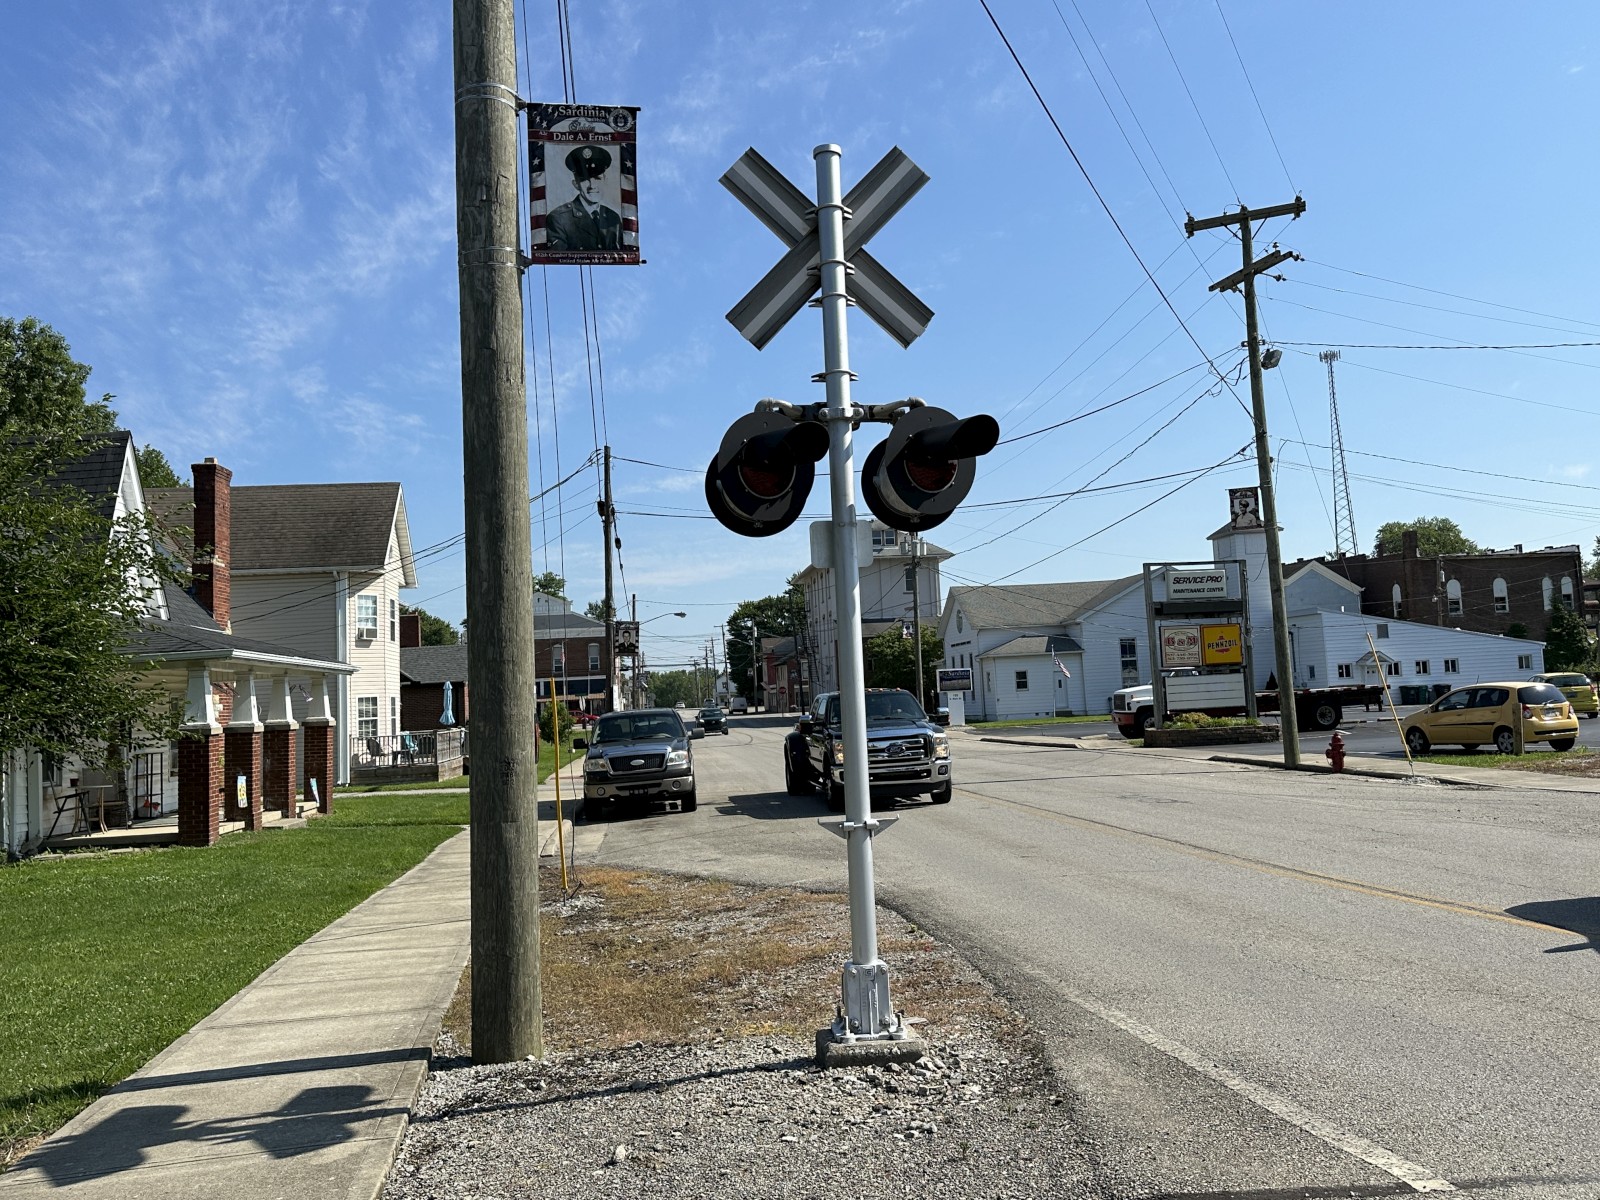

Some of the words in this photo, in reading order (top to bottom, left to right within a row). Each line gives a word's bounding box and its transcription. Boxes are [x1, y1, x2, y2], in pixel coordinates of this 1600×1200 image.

[558, 105, 605, 117] Sardinia
[553, 132, 574, 141] Dale
[576, 132, 586, 141] A.
[588, 133, 612, 141] Ernst
[1173, 576, 1206, 585] SERVICE
[1206, 575, 1223, 584] PRO
[1207, 639, 1238, 650] PENNZOIL
